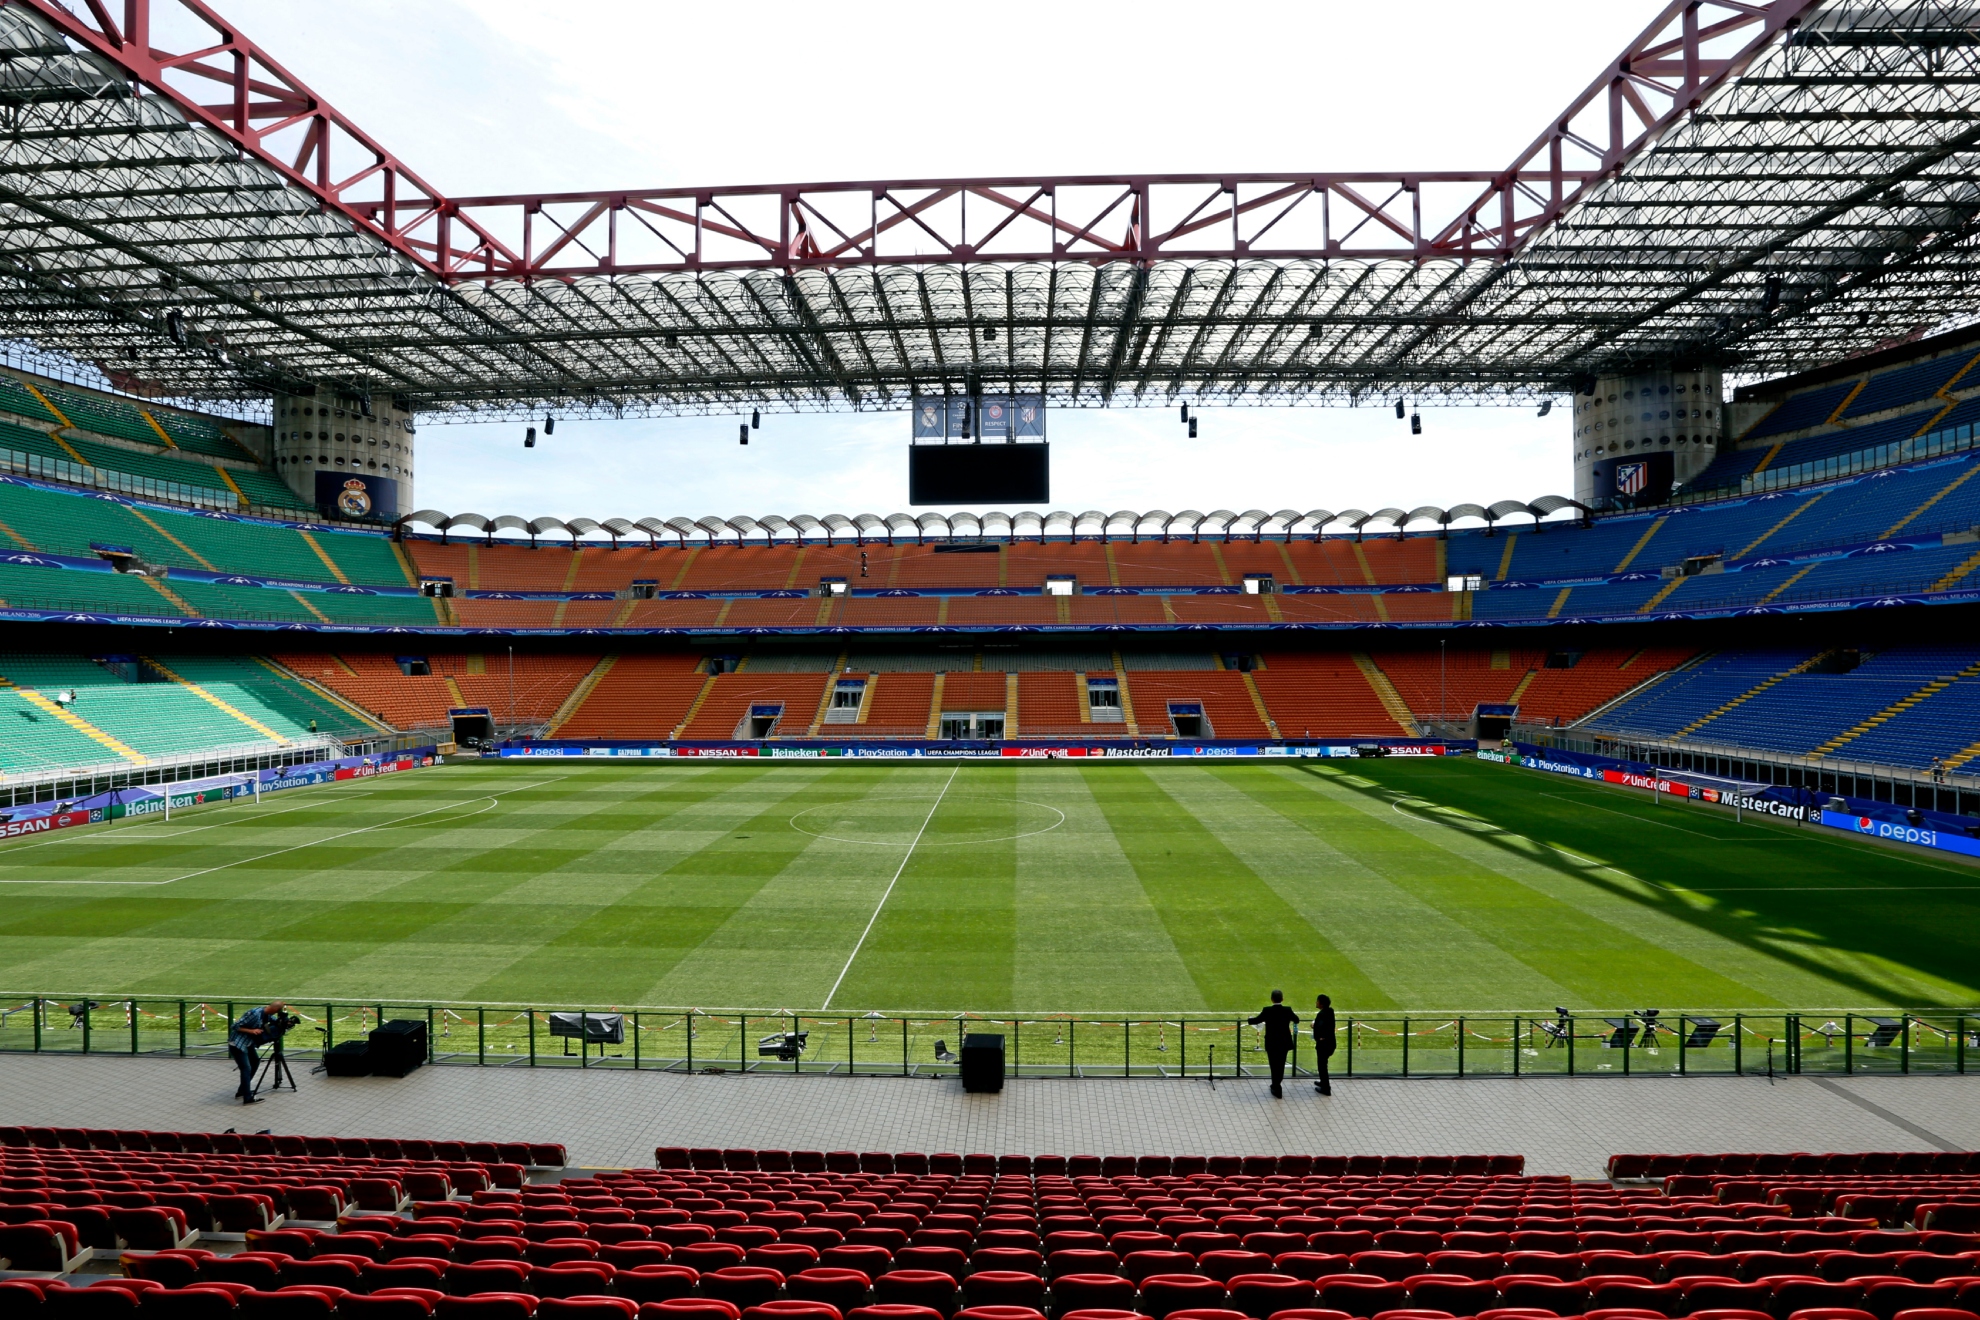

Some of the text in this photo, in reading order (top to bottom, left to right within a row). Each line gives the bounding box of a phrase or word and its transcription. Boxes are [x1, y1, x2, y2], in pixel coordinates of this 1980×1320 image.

[772, 748, 818, 756] Heineken
[1106, 748, 1168, 756] MasterCard
[1206, 747, 1237, 755] pepsi
[362, 763, 397, 776] Uniredit
[1538, 760, 1580, 775] PlayStation
[125, 796, 193, 817] Heineken
[1721, 792, 1804, 819] MasterCard
[1880, 824, 1936, 846] pepsi
